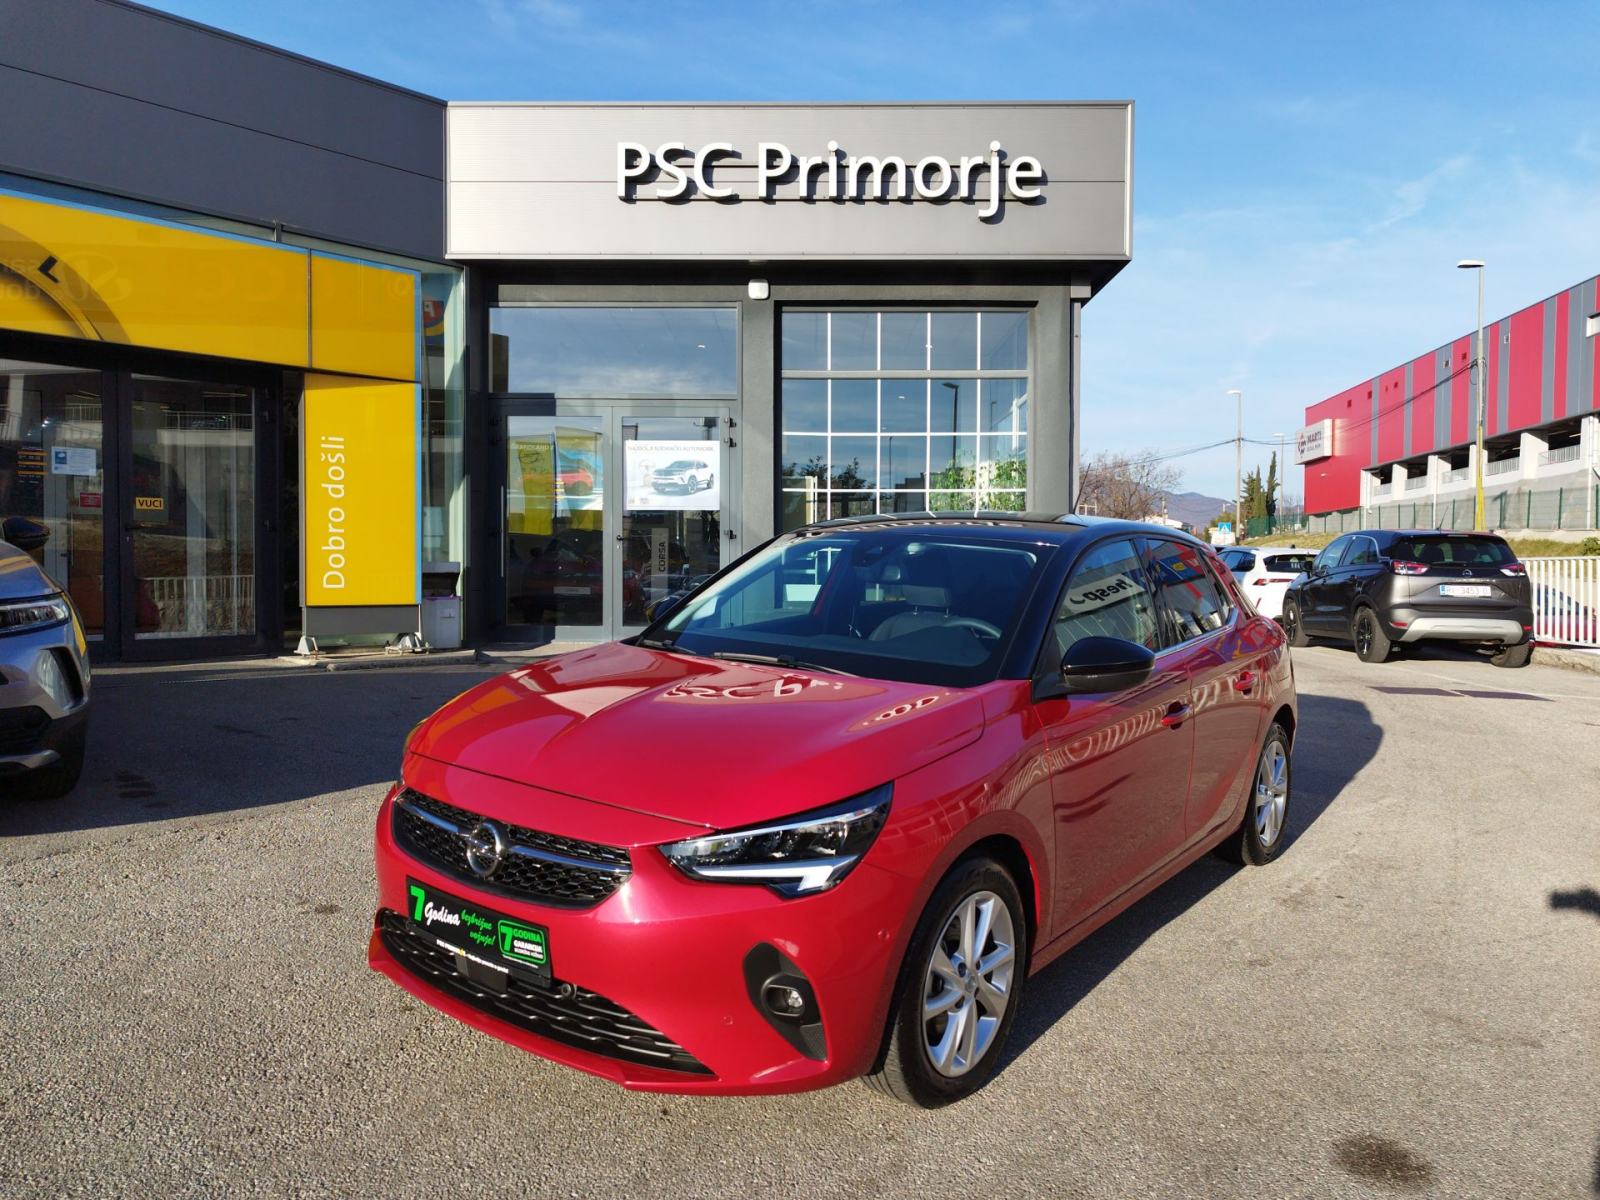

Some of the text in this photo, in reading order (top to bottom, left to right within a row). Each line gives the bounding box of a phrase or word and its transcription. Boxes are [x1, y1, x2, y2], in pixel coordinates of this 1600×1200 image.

[617, 140, 1044, 219] PSC Primorje
[138, 499, 162, 508] VUCI
[321, 436, 345, 588] Dobro došli
[658, 541, 667, 572] CORSA
[410, 885, 426, 921] 7
[424, 901, 461, 927] Godina
[500, 925, 542, 952] 7 GODINA
